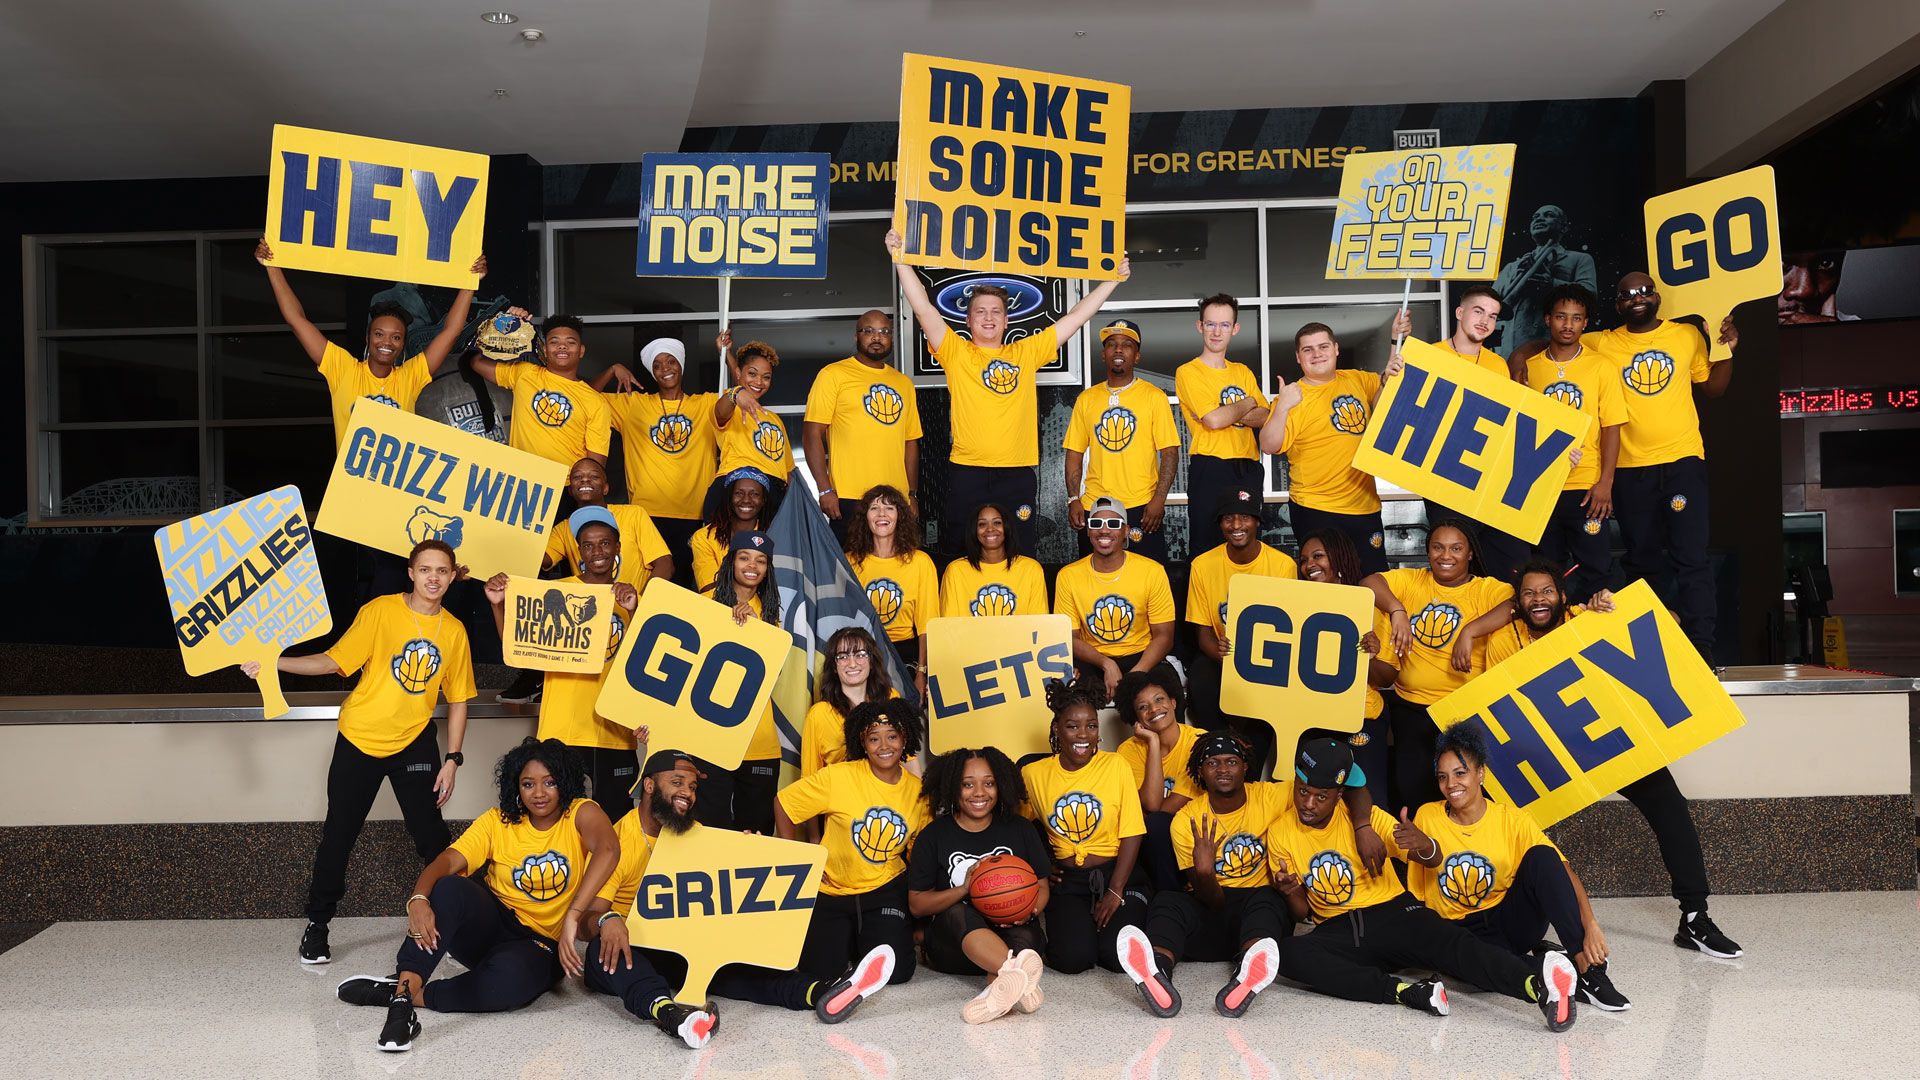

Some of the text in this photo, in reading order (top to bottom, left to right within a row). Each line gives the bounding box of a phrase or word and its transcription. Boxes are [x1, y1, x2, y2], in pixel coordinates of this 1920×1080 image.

[928, 66, 1109, 145] MAKE
[1398, 134, 1435, 148] BUILT
[653, 164, 817, 210] MAKE
[928, 135, 1103, 208] SOME
[1132, 151, 1191, 175] FOR
[1402, 154, 1442, 184] ON
[279, 150, 480, 263] HEY
[904, 199, 1116, 272] NOISE!
[1335, 203, 1494, 271] FEET!
[1366, 181, 1468, 223] YOUR
[648, 215, 818, 266] NOISE
[1655, 196, 1769, 287] GO
[1372, 362, 1576, 512] HEY
[343, 426, 555, 535] GRIZZ WIN!
[174, 513, 312, 648] GRIZZLIES
[516, 594, 543, 623] BIG
[514, 619, 593, 650] MEMPHIS
[624, 613, 766, 728] GO
[1233, 603, 1360, 695] GO
[928, 630, 1074, 720] LET'S
[1461, 609, 1694, 809] HEY
[636, 863, 817, 920] GRIZZ
